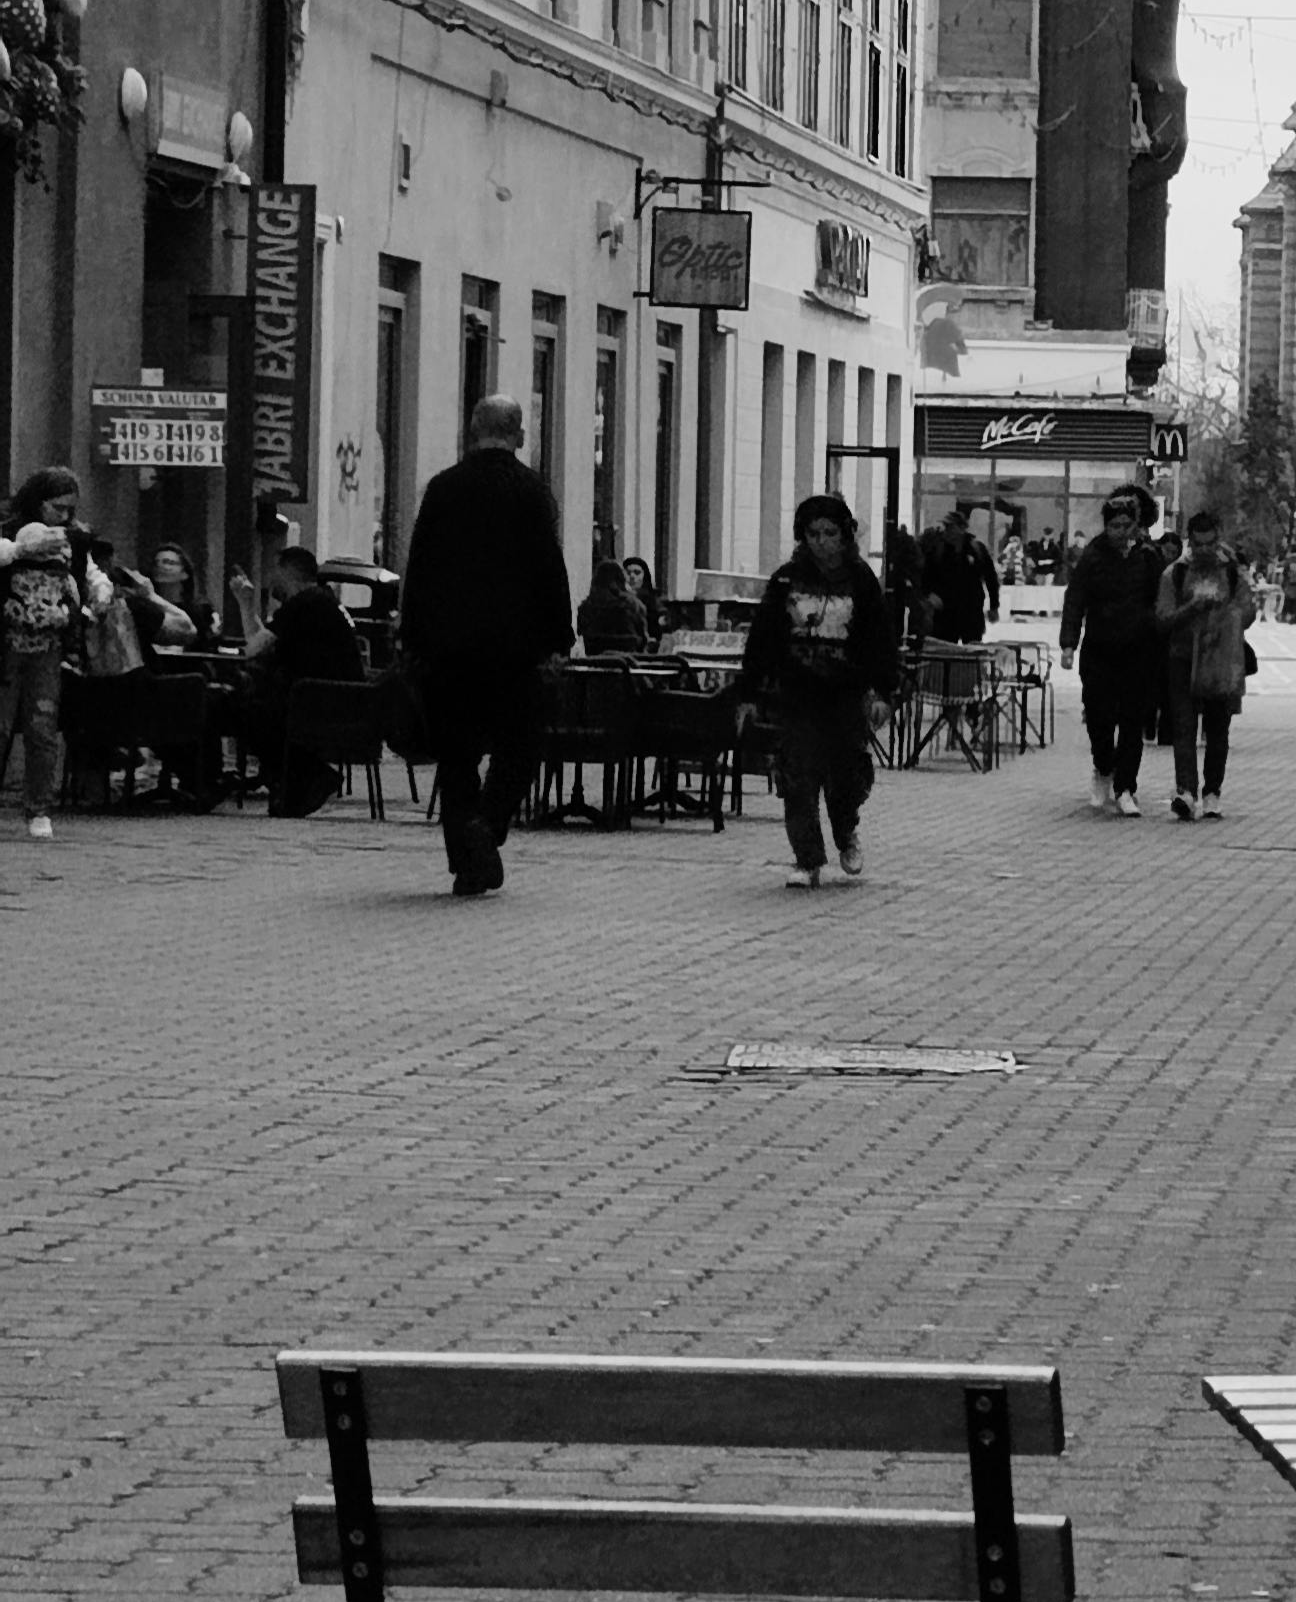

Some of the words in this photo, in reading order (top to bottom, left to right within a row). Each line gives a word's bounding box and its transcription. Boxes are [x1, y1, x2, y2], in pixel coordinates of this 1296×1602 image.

[253, 190, 300, 380] EXCHANGE
[658, 235, 743, 279] Optic
[253, 393, 300, 499] JABRI
